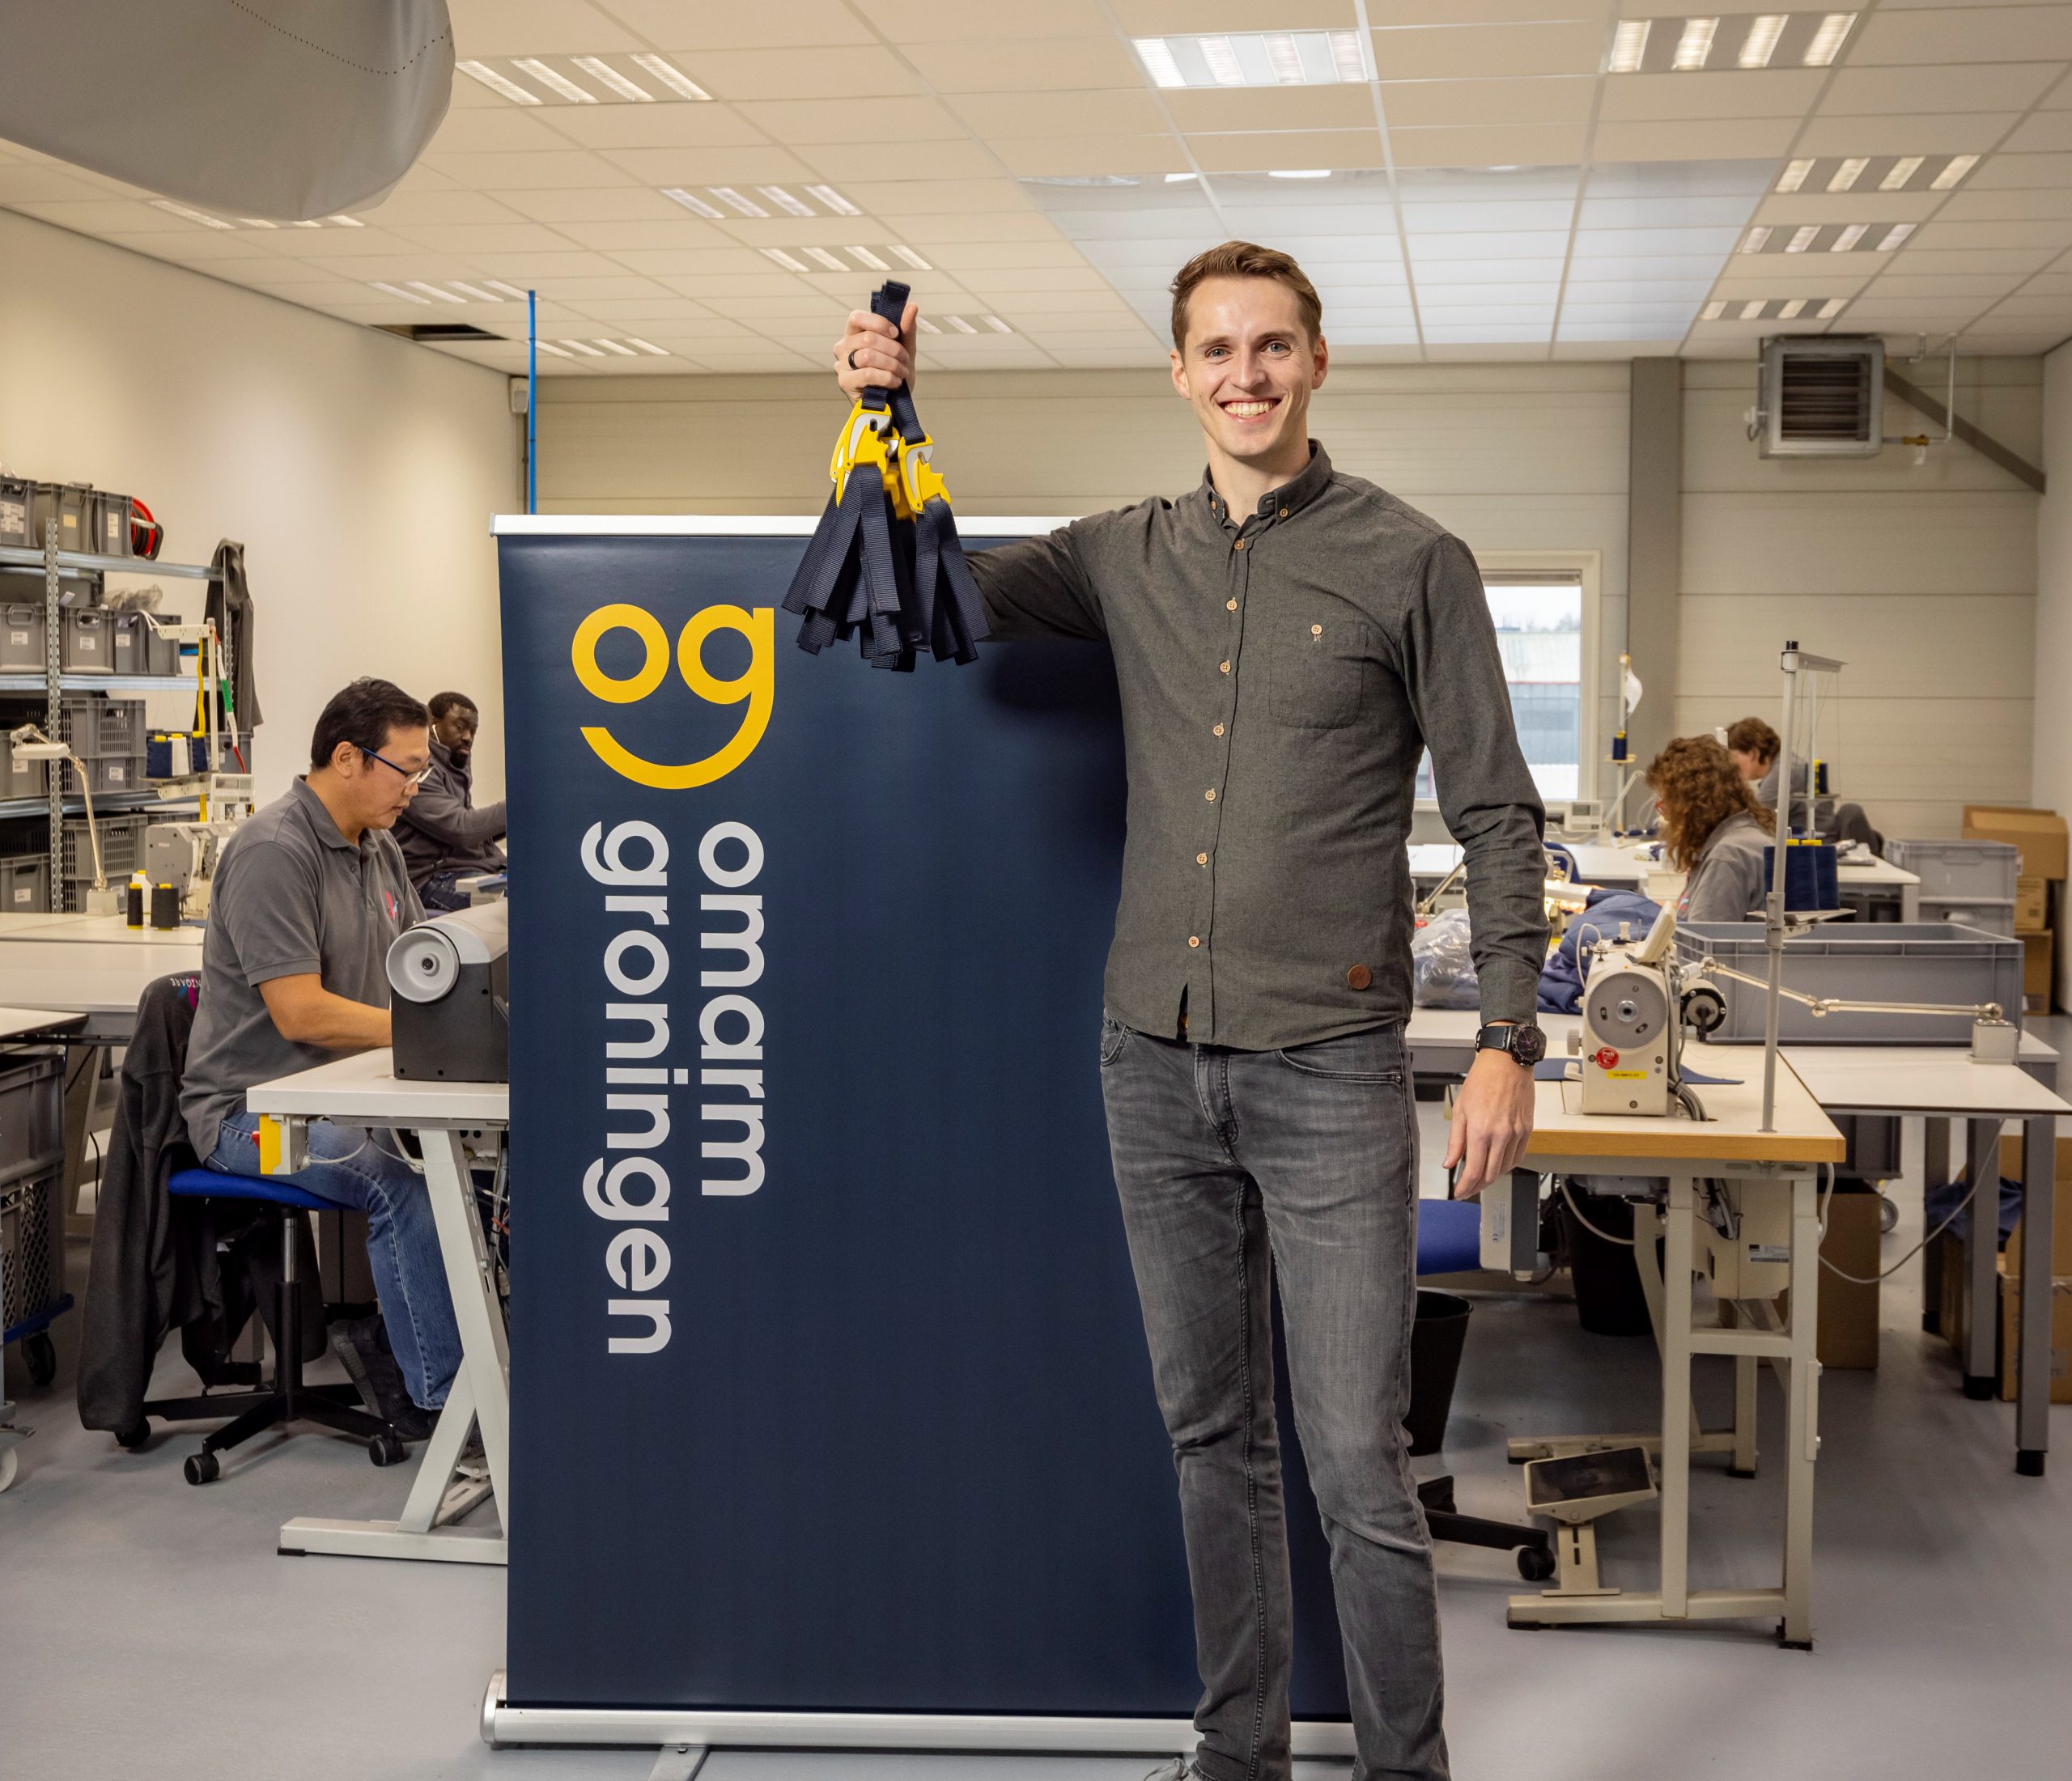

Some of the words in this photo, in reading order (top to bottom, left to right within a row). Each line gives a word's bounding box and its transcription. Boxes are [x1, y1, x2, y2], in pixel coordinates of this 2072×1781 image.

[571, 603, 775, 790] og
[580, 820, 688, 1354] groningen
[698, 821, 765, 1197] omarm
